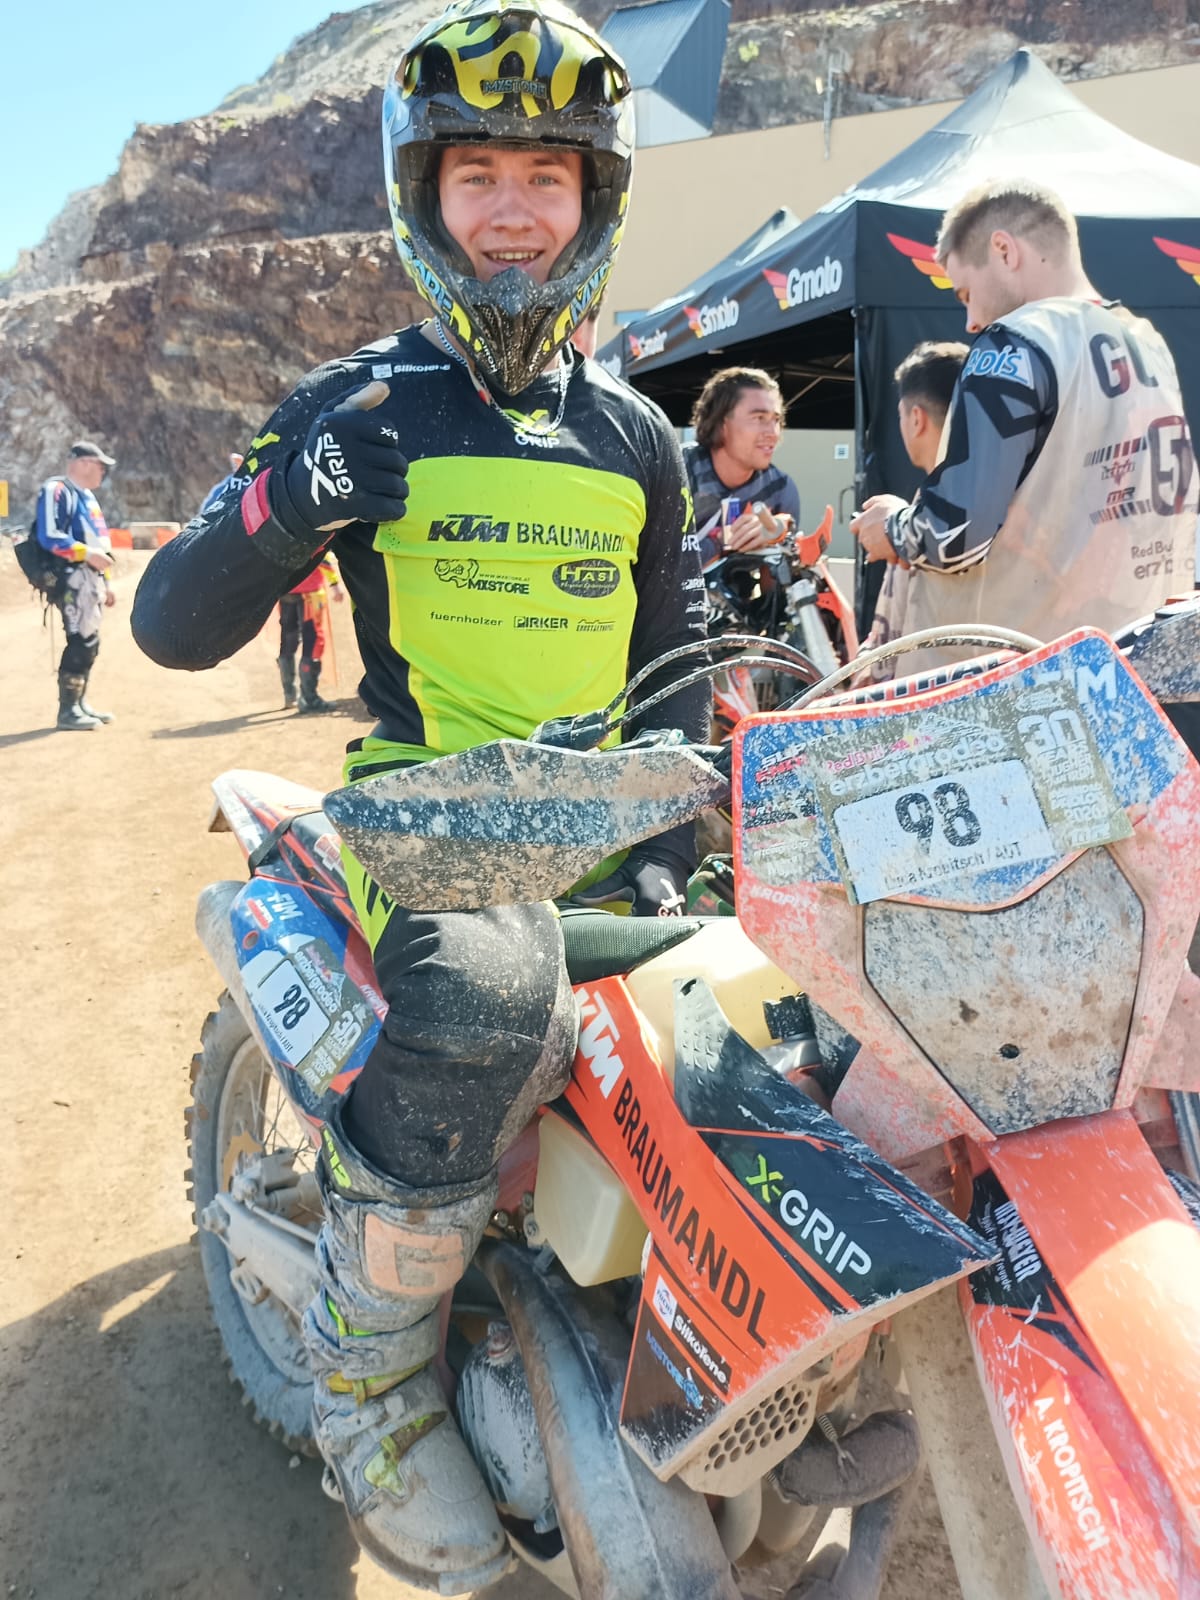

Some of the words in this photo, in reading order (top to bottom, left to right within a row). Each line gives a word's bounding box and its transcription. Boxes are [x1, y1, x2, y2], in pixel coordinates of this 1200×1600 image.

[786, 256, 843, 307] Gmoto
[697, 296, 740, 336] Gmoto
[323, 432, 354, 494] GRIP
[427, 514, 511, 543] KTM
[560, 565, 617, 582] HAST
[1017, 708, 1087, 751] 30
[895, 782, 982, 855] 98
[273, 983, 311, 1031] 98
[331, 1010, 362, 1047] 30
[612, 1077, 768, 1349] BRAUMANDL
[746, 1153, 872, 1276] X-GRIP
[674, 1314, 727, 1384] Silkolene
[1033, 1396, 1056, 1422] A.
[1043, 1418, 1111, 1552] KROPITSCH
